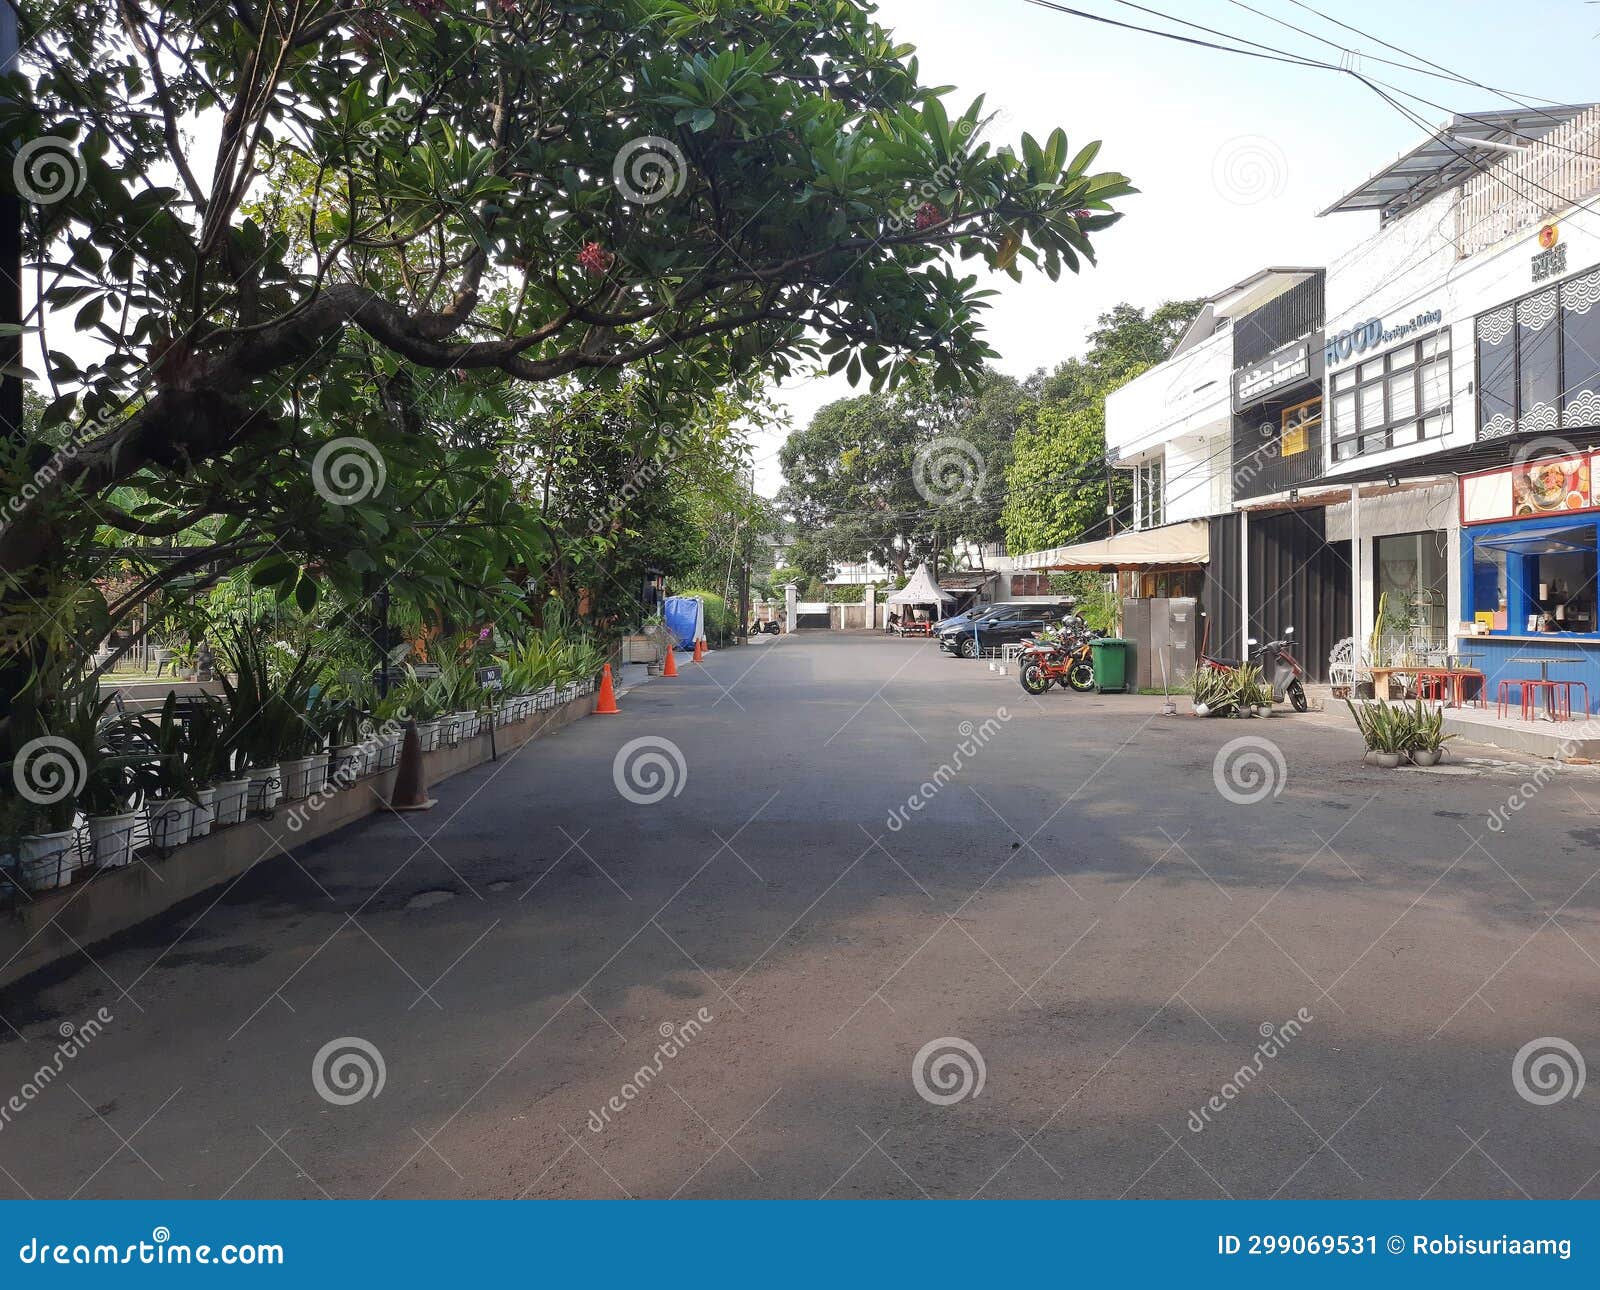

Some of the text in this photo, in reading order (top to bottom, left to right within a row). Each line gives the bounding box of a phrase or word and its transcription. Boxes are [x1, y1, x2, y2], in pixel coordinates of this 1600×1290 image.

[1324, 316, 1383, 368] HOOD
[1382, 324, 1410, 344] design
[1416, 308, 1442, 327] living
[487, 670, 496, 681] NO
